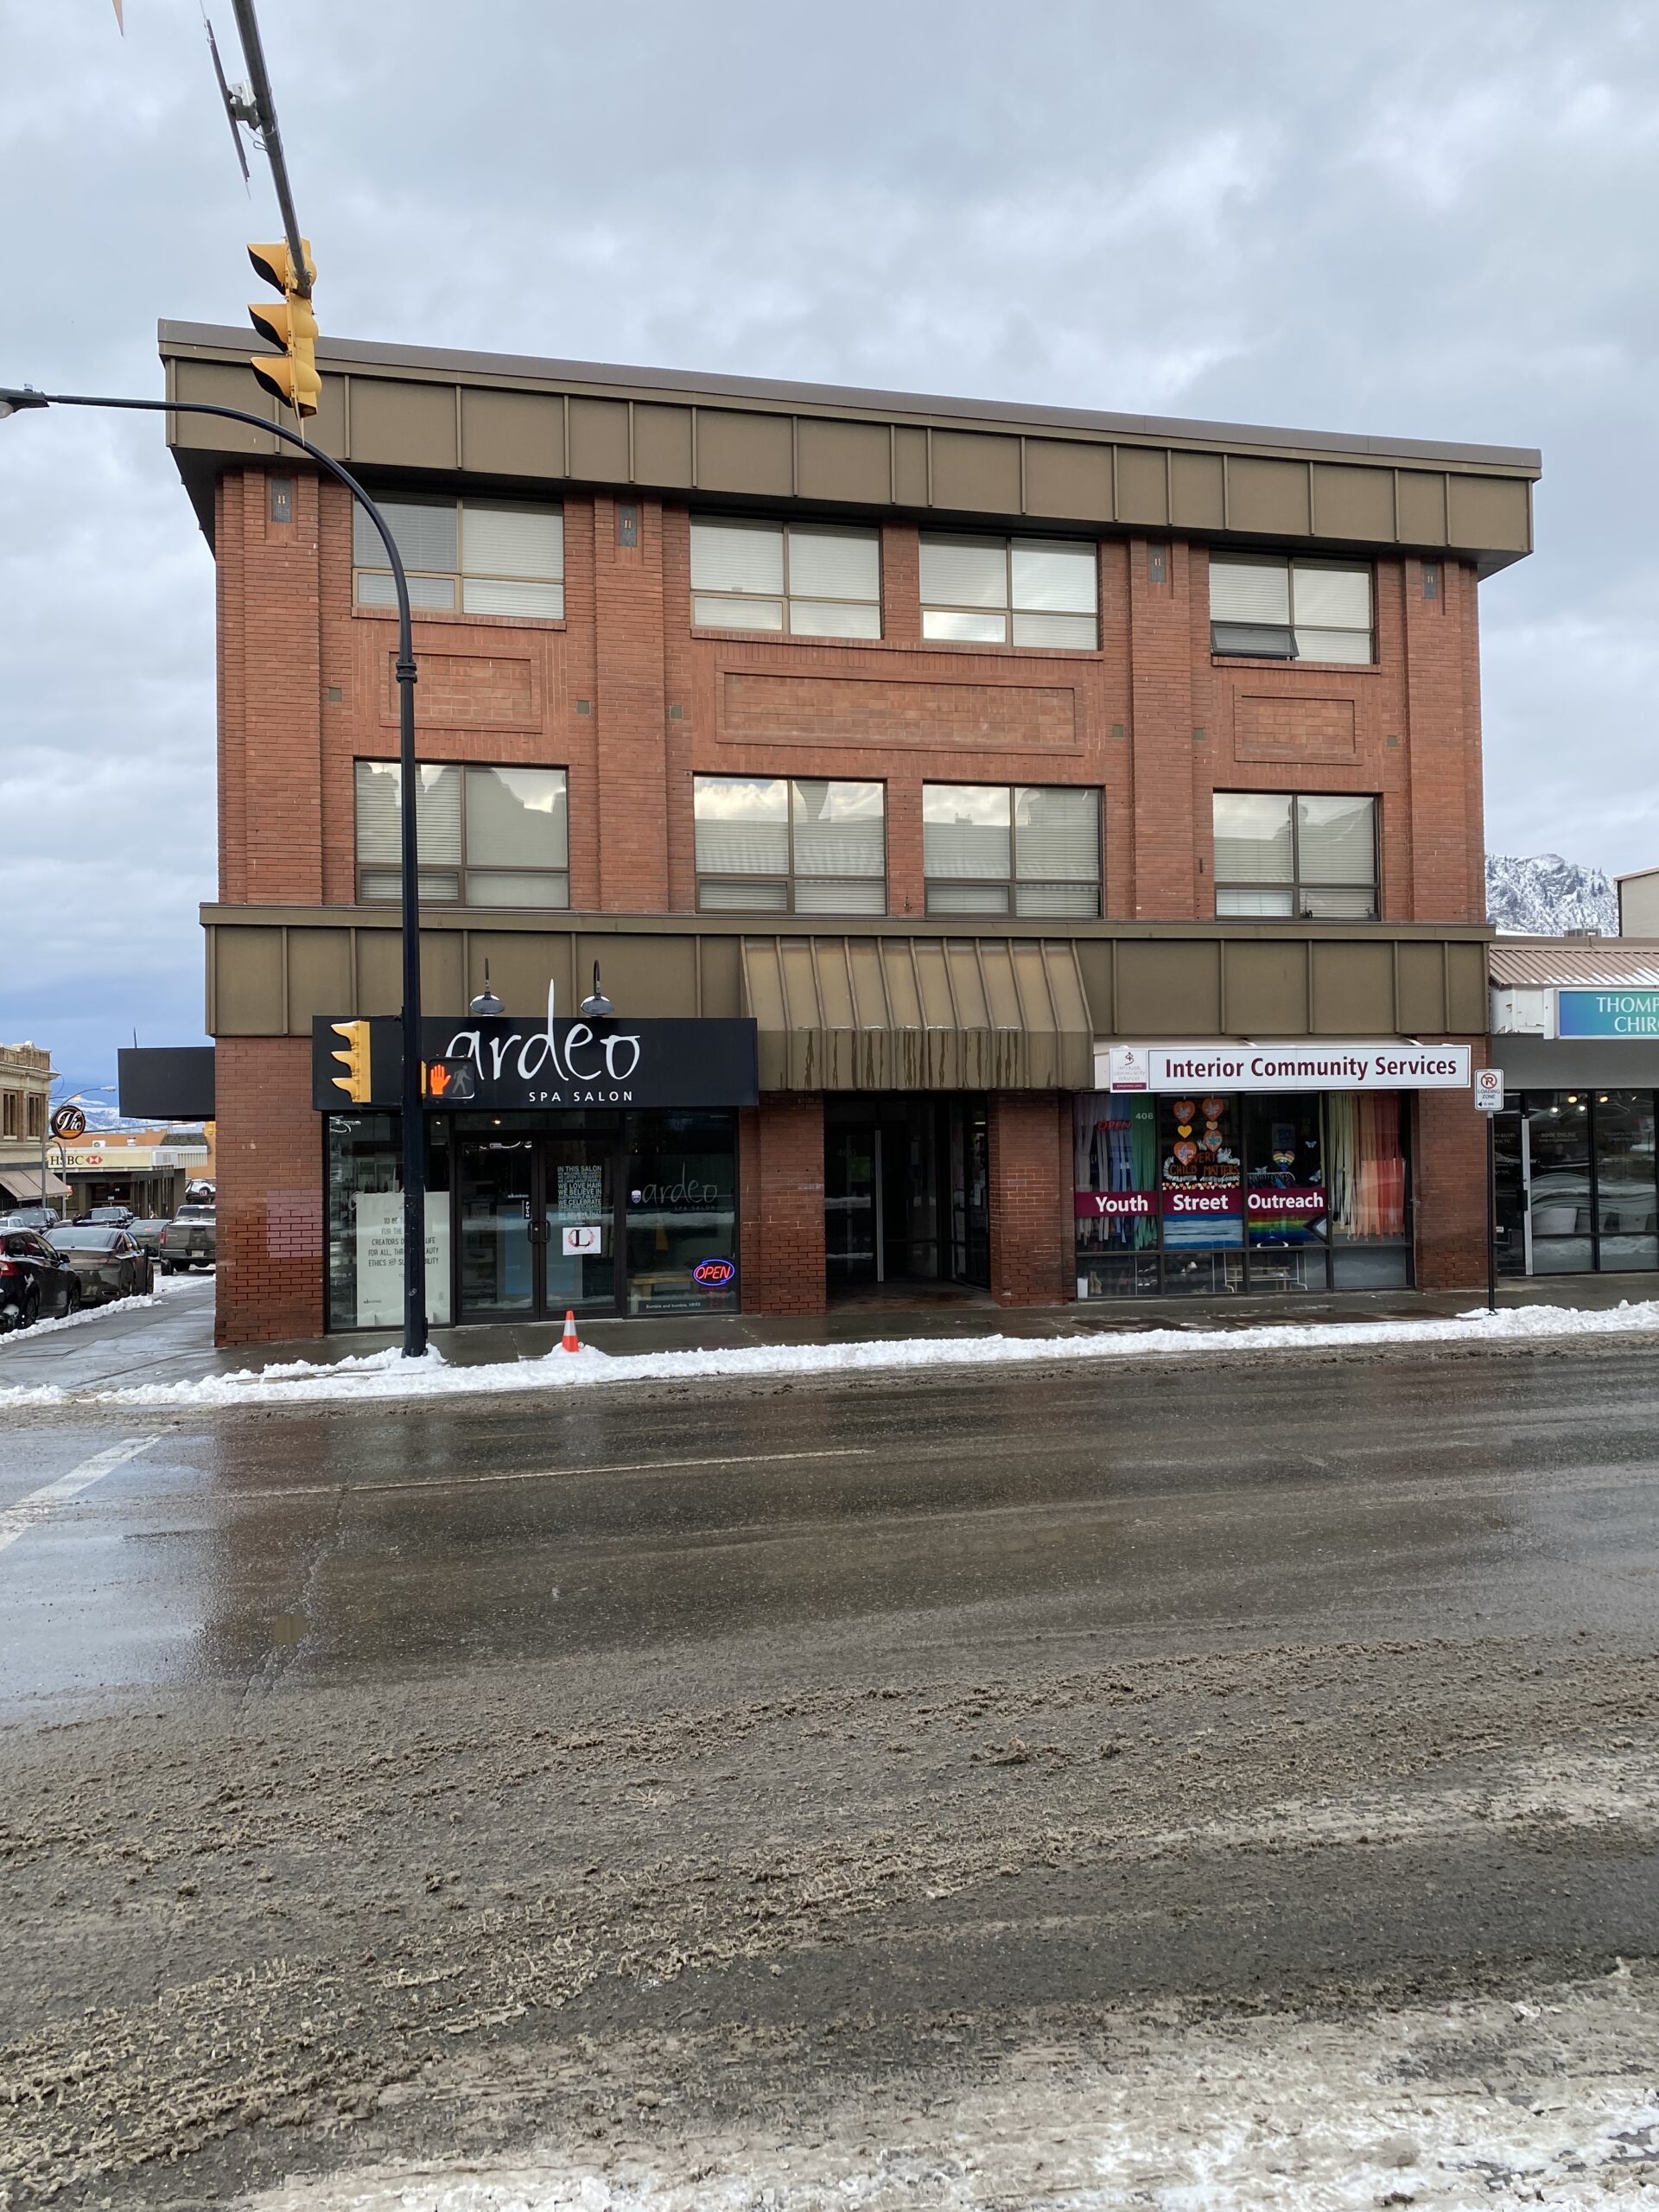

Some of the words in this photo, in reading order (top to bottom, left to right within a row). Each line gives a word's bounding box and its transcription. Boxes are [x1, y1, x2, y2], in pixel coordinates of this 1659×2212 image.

[444, 977, 641, 1081] ardeo
[1614, 1016, 1659, 1033] CHIR
[1166, 1057, 1243, 1078] Interior
[1251, 1055, 1368, 1081] Community
[1375, 1054, 1457, 1077] Services
[529, 1091, 562, 1102] SPA
[573, 1090, 632, 1102] SALON
[57, 1110, 83, 1131] Vic
[1170, 1164, 1198, 1175] CHILD
[642, 1160, 717, 1205] ardeo
[1096, 1195, 1148, 1212] Youth
[1173, 1193, 1229, 1211] Street
[1247, 1192, 1324, 1209] Outreach
[372, 1237, 399, 1246] CREATORS
[695, 1265, 731, 1280] OPEN
